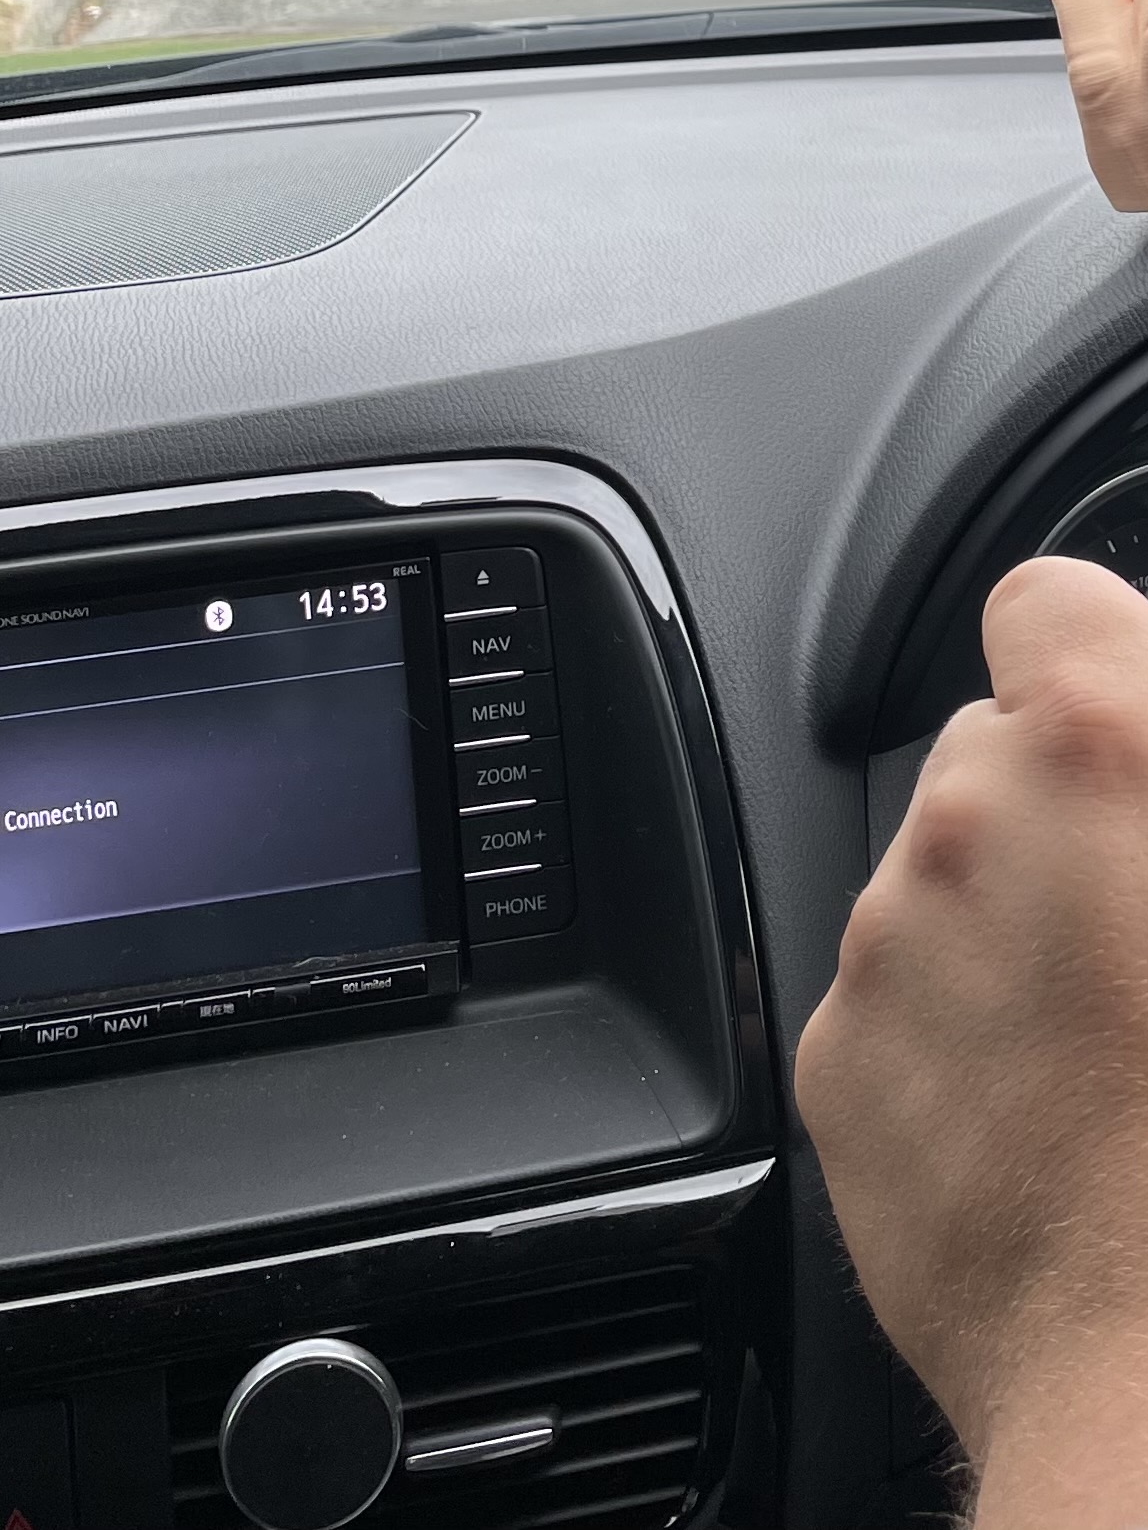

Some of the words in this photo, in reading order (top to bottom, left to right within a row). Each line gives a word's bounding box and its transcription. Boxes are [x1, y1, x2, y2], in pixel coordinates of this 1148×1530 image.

[393, 565, 421, 577] REAL
[299, 582, 388, 620] 14:53
[472, 635, 511, 655] NAV
[472, 700, 526, 722] MENU
[5, 799, 118, 831] Connection
[485, 895, 547, 918] PHONE
[37, 1025, 78, 1044] INFO
[104, 1014, 148, 1034] NAVI
